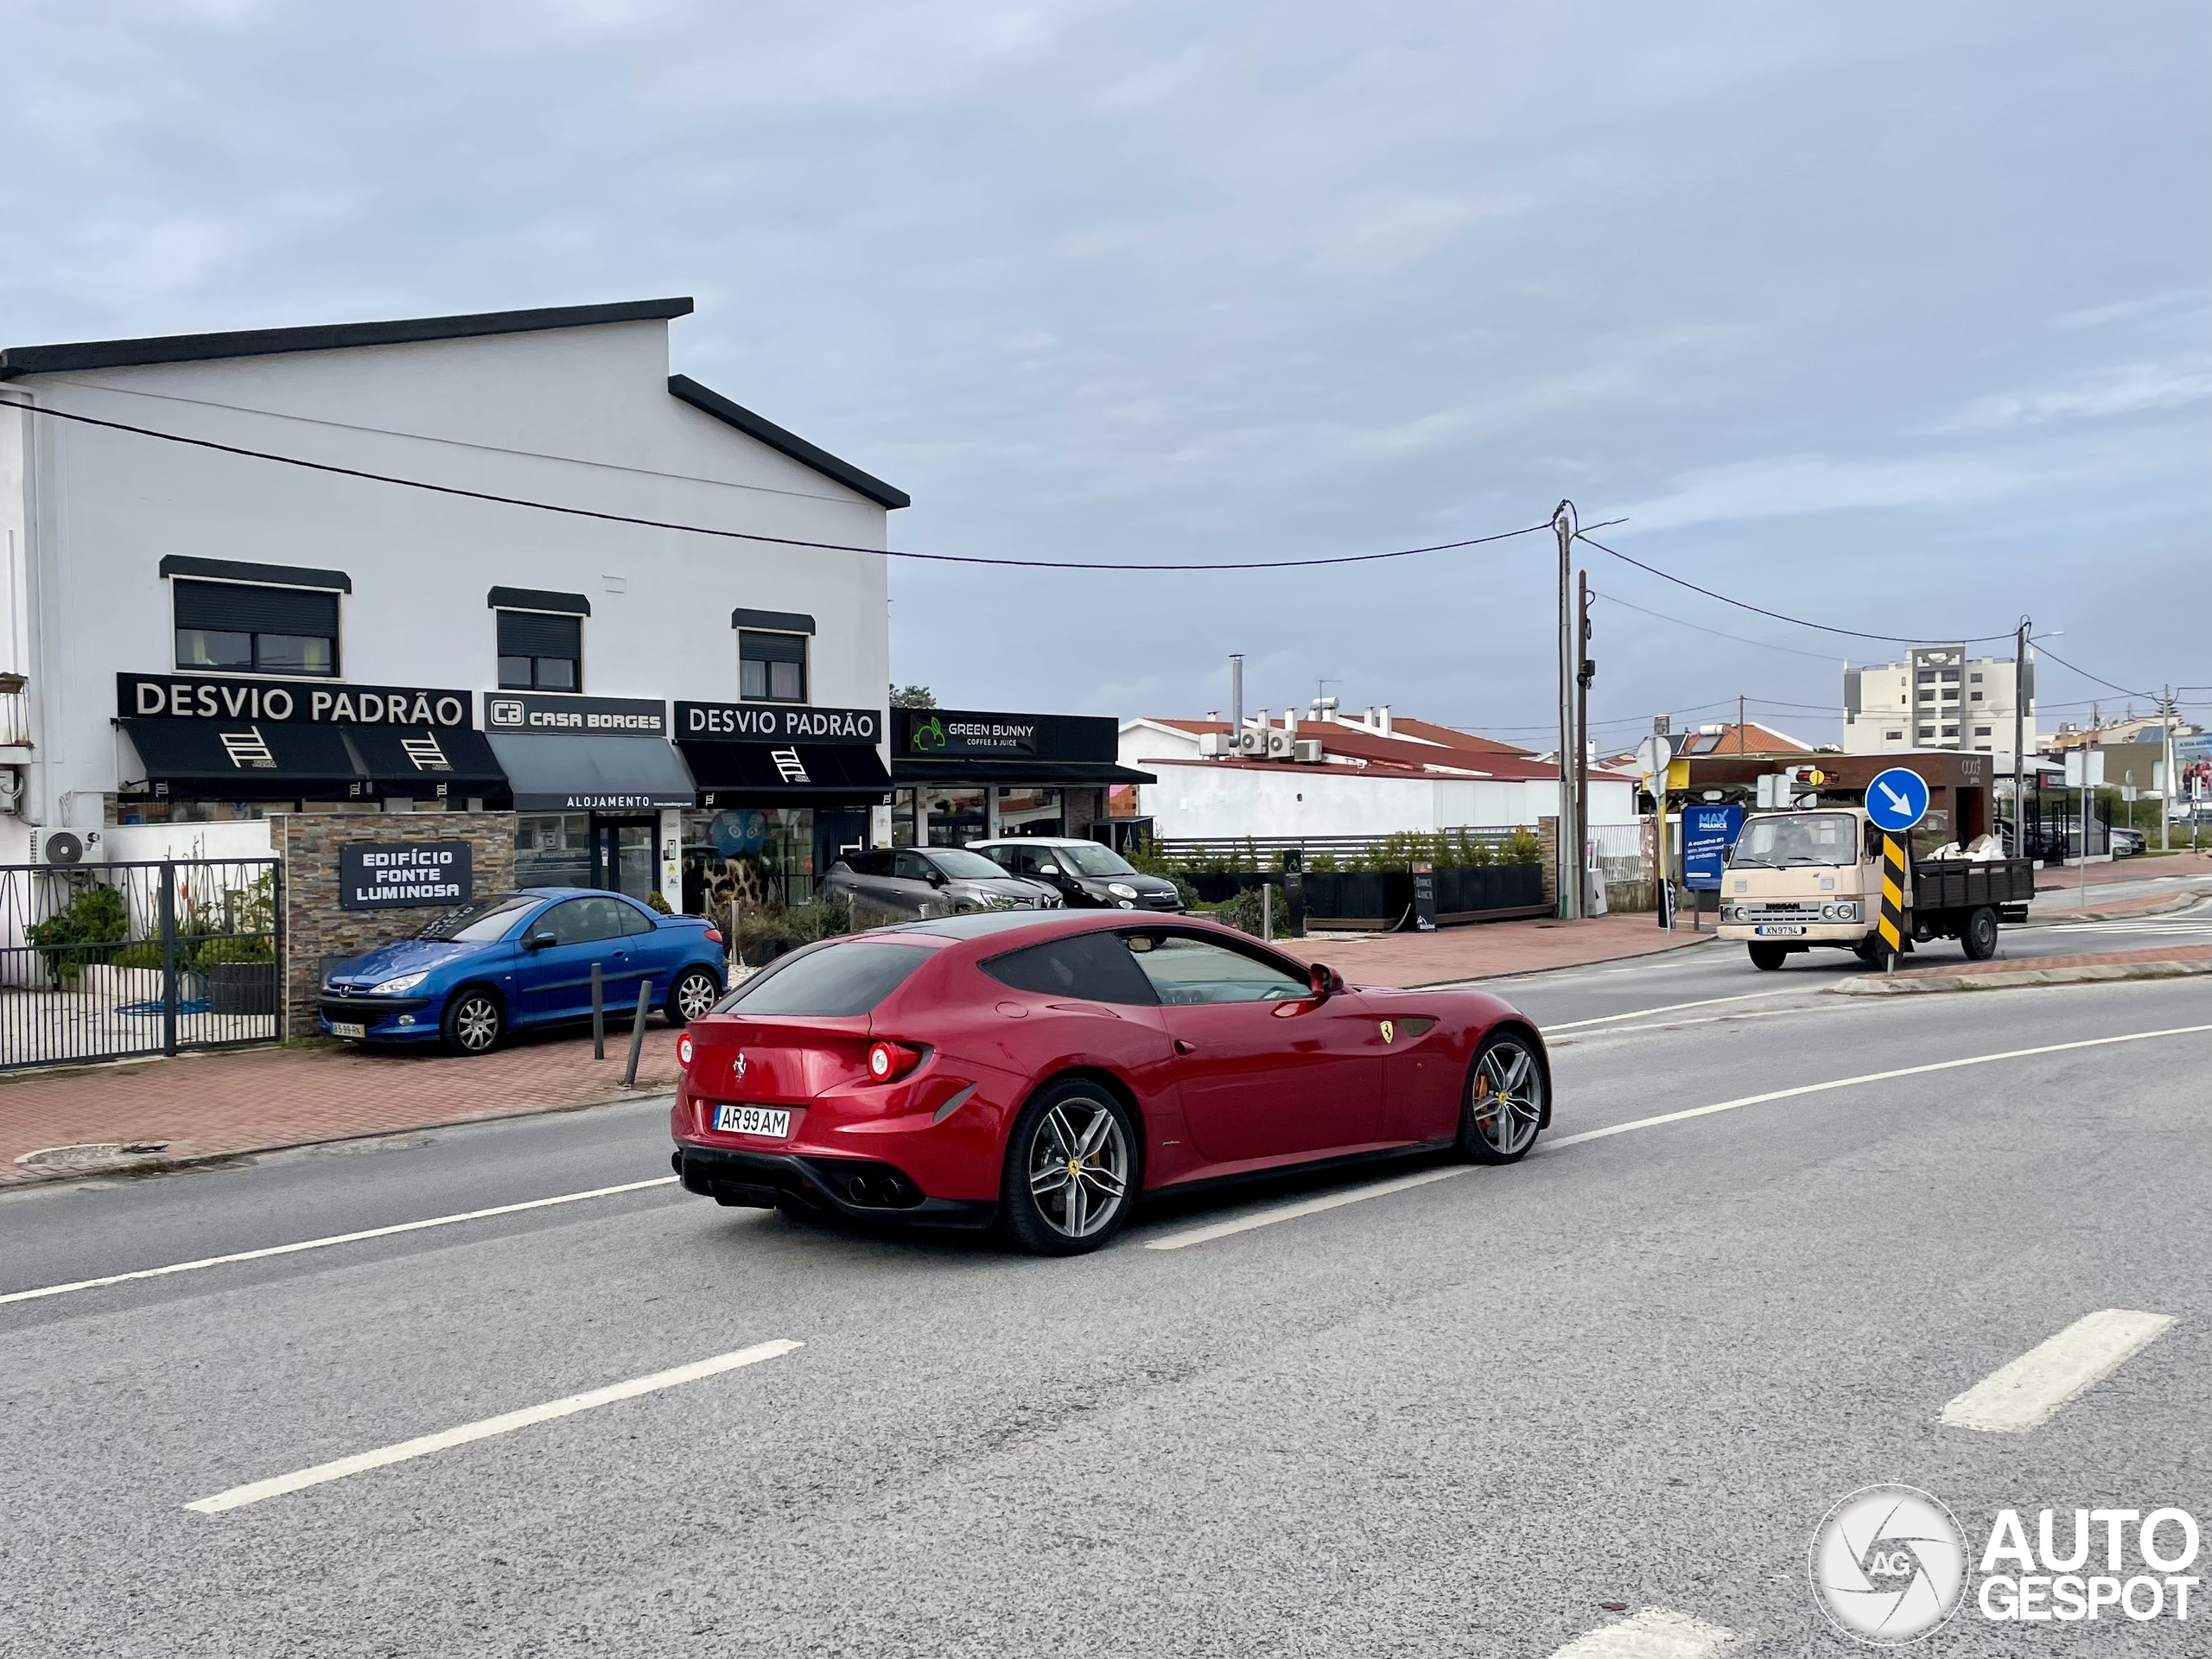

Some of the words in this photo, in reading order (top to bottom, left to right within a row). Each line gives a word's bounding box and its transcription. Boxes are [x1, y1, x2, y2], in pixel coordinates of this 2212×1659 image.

[136, 683, 294, 721] DESVIO
[312, 691, 463, 727] PADRÃO
[530, 712, 582, 728] CASA
[588, 714, 662, 730] BORGES
[690, 709, 777, 734] DESVIO
[786, 712, 874, 739] PADRÃO
[948, 723, 989, 735] GREEN
[993, 725, 1034, 737] BUNNY
[567, 796, 650, 807] ALOJAMENTO
[1699, 809, 1729, 824] MAX
[363, 849, 454, 867] EDIFÍCIO
[376, 868, 441, 883] FONTE
[356, 884, 460, 901] LUMINOSA
